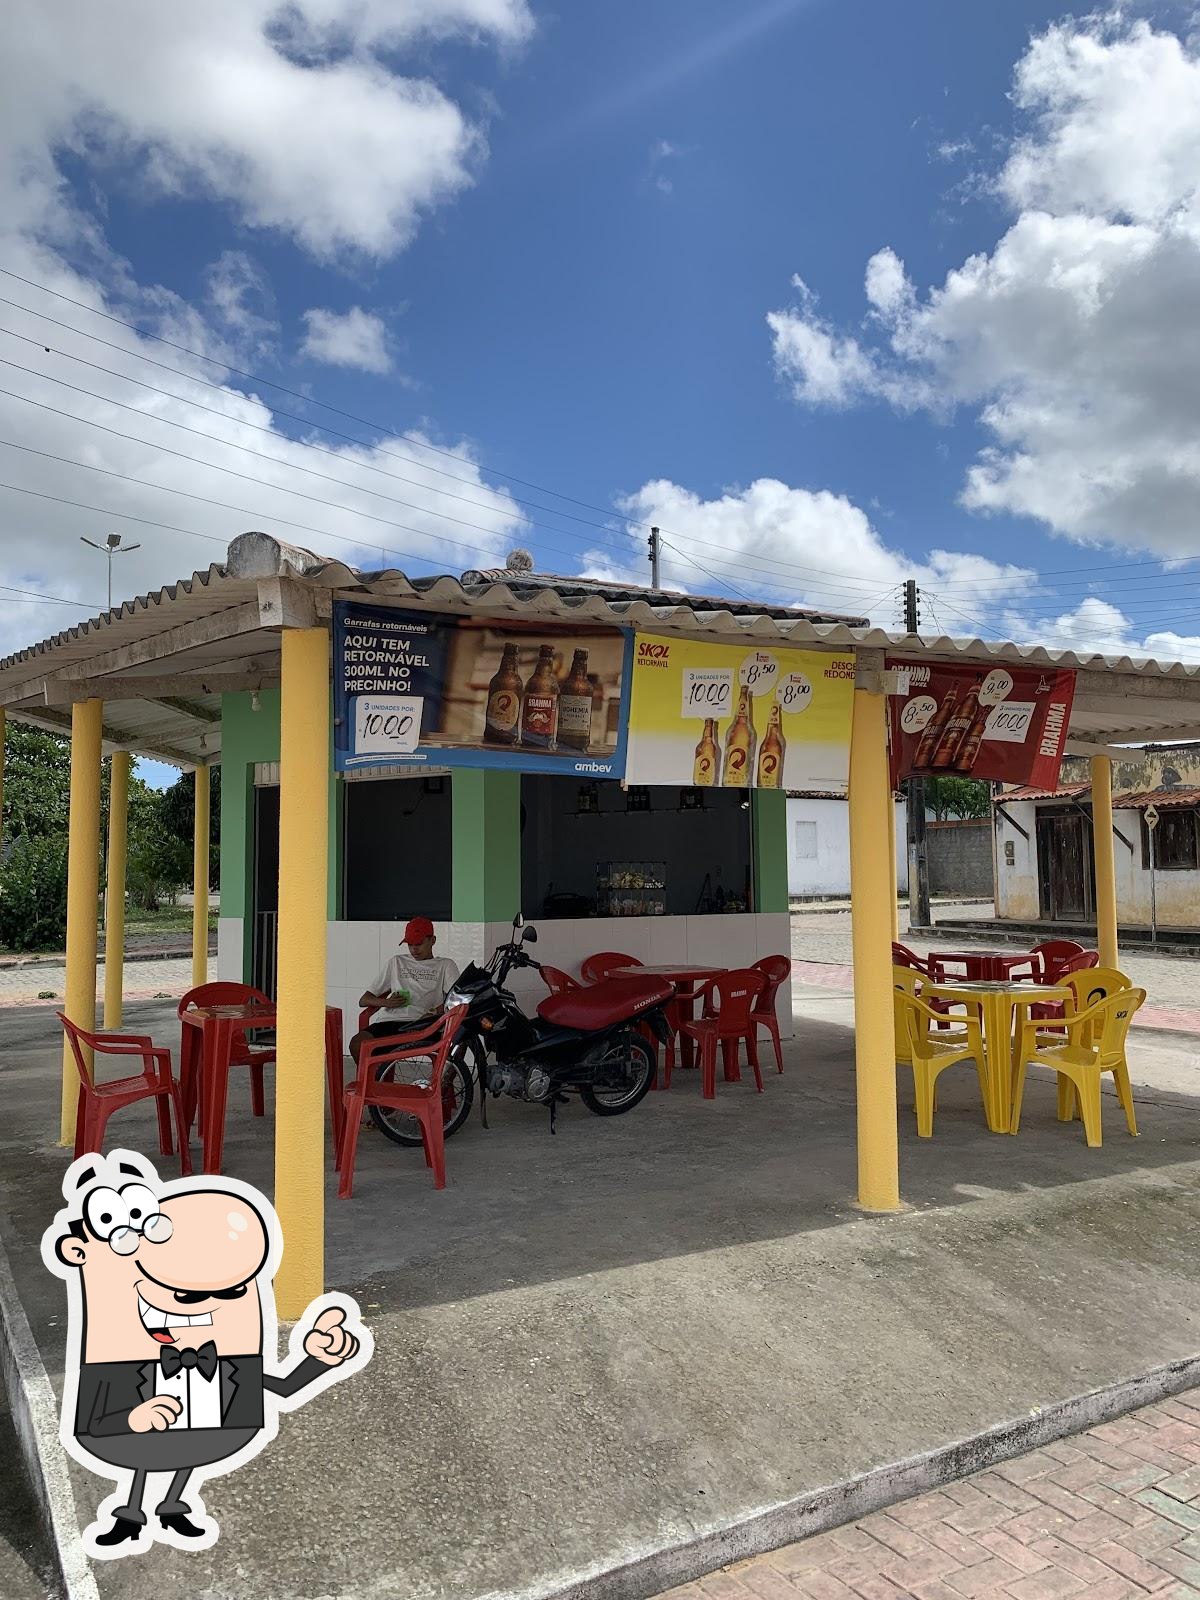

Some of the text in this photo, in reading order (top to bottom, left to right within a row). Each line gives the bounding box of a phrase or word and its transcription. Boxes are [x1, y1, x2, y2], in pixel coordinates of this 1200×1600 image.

[344, 618, 428, 632] Garrafas retornáveis
[344, 635, 410, 650] AQUI TEM
[638, 643, 670, 658] SKOL
[344, 650, 430, 667] RETORNÁVEL
[832, 661, 857, 670] DESCE
[344, 665, 410, 677] 300ML NO
[747, 664, 776, 684] 8,50
[344, 680, 411, 692] PRECINHO!
[783, 684, 810, 704] 8,00
[364, 702, 370, 710] 3
[371, 704, 400, 712] UNIDADES
[1039, 703, 1067, 757] BRAHMA
[574, 762, 612, 773] ambev
[633, 994, 661, 1011] HONDA
